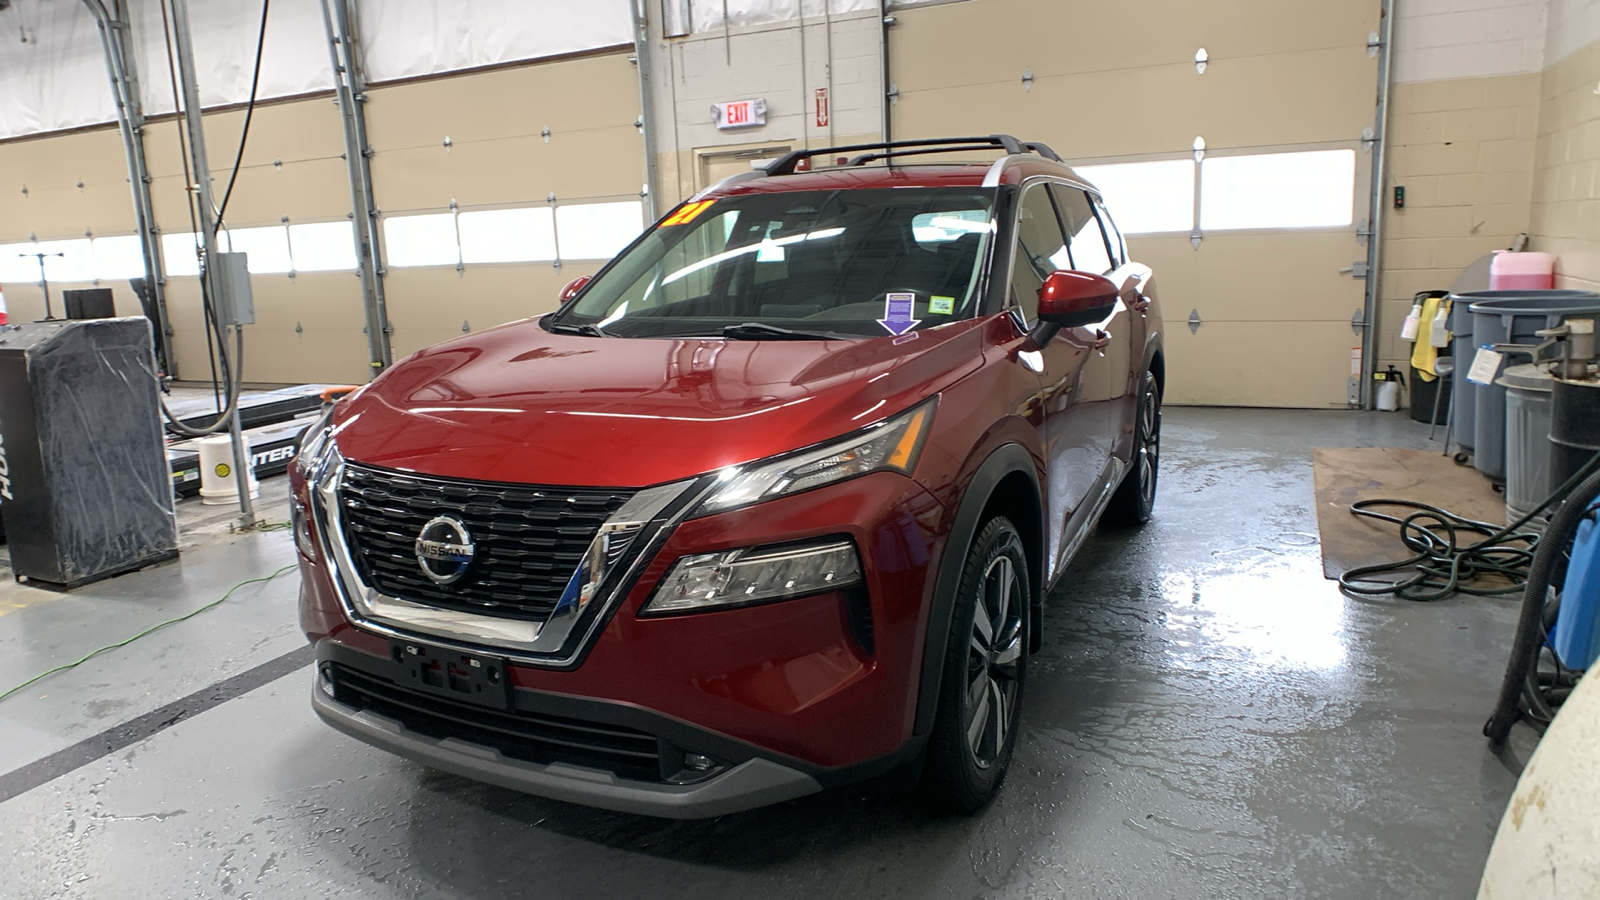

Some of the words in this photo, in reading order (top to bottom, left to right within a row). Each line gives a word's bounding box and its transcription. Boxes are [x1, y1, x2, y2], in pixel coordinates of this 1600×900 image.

[727, 102, 748, 124] EXIT
[660, 199, 715, 227] 21
[419, 542, 467, 556] NISSAN
